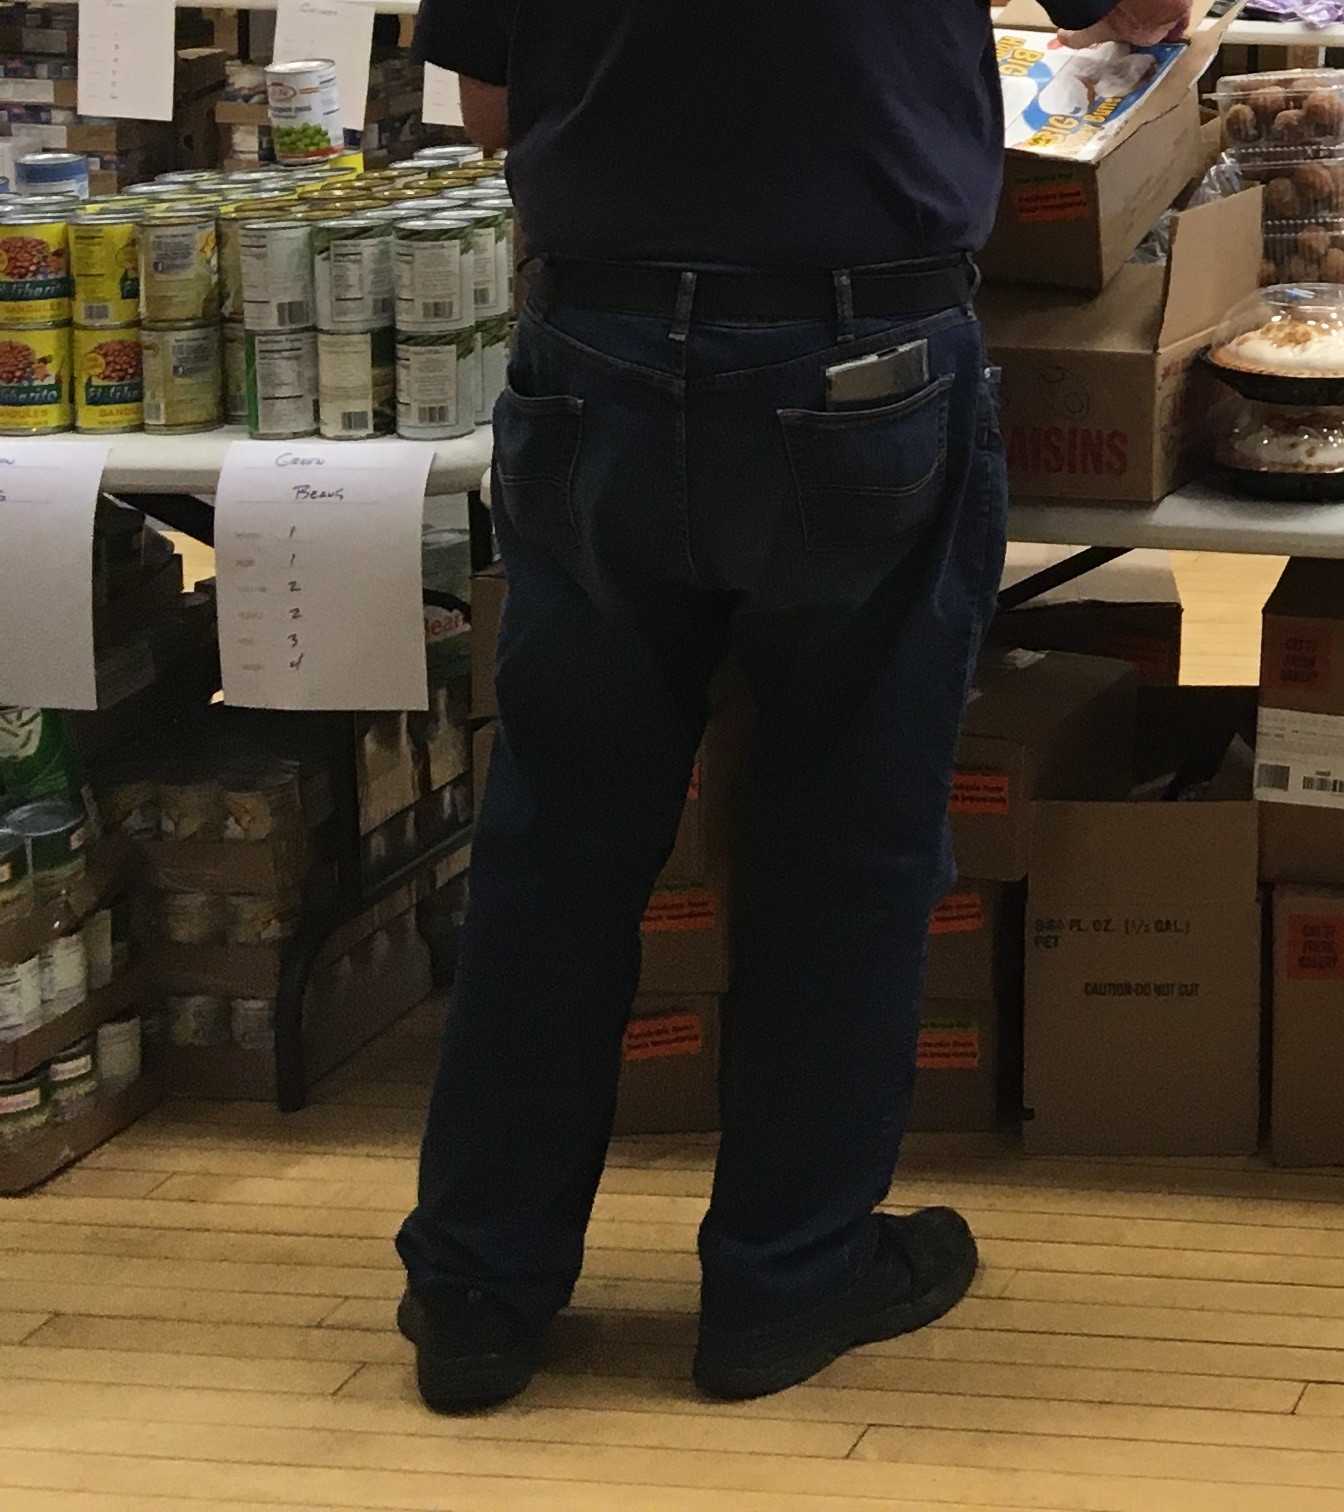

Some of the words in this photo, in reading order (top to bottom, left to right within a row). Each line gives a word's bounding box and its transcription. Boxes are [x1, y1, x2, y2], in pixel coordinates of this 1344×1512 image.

[1007, 425, 1129, 476] AISINS
[288, 580, 302, 592] 2
[289, 607, 302, 619] 2
[287, 633, 298, 648] 3
[289, 653, 304, 671] 4
